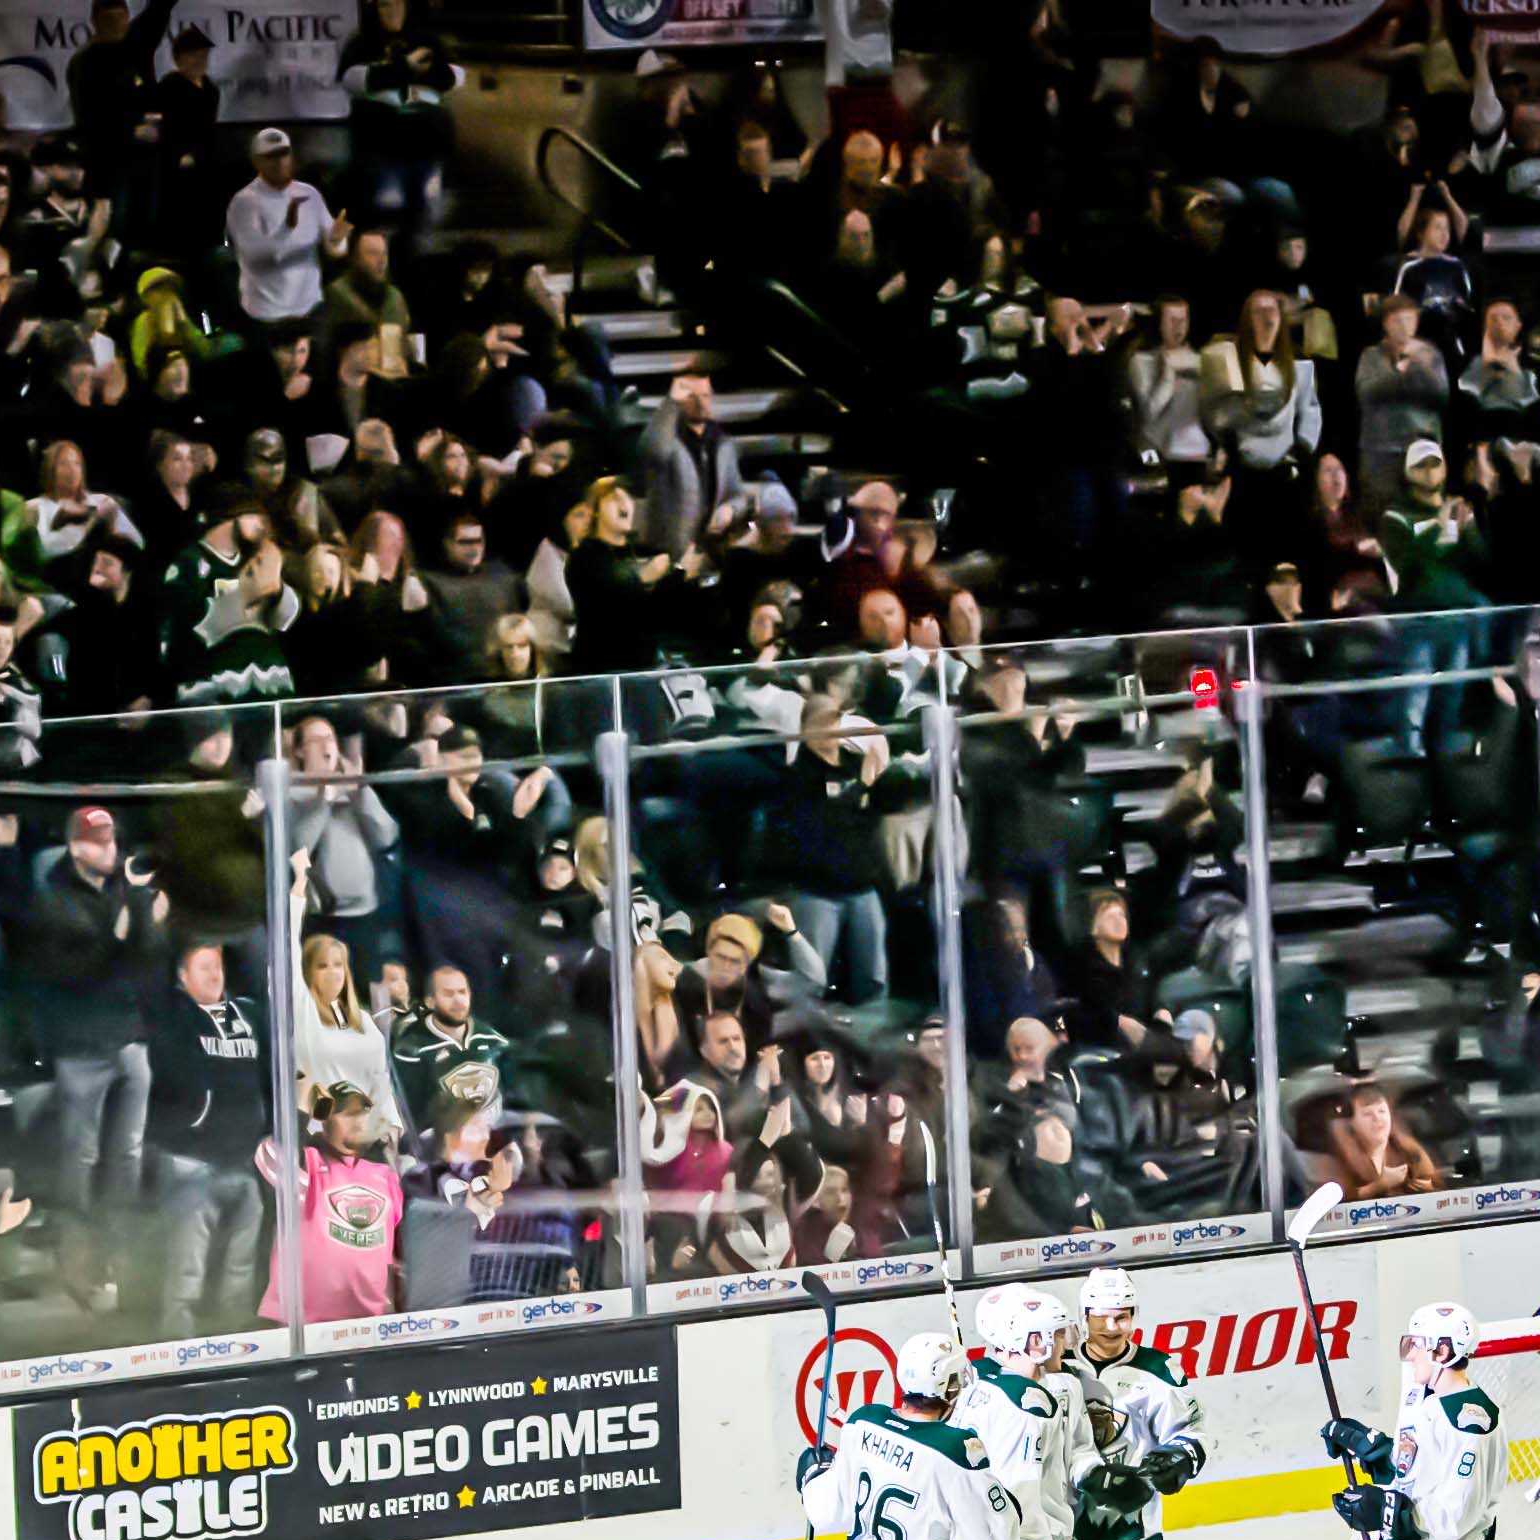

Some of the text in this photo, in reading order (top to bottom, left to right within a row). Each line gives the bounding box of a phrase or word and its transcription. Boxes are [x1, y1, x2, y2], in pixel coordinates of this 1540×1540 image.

[226, 10, 343, 43] PACIFIC
[1475, 1187, 1528, 1210] gerber
[1349, 1201, 1402, 1225] gerber
[1173, 1223, 1229, 1247] gerber
[1041, 1238, 1098, 1262] gerber
[857, 1260, 914, 1284] gerber
[719, 1276, 775, 1301] gerber
[522, 1299, 579, 1323] gerber
[378, 1316, 435, 1340] gerber
[177, 1340, 236, 1366] gerber
[28, 1358, 87, 1383] gerber
[316, 1366, 659, 1421] EDMONDS LYNNWOOD MARYSVILLE
[41, 1415, 291, 1495] ANOTHER
[317, 1402, 660, 1487] VIDEO GAMES
[861, 1430, 915, 1473] KHAIRA
[1457, 1451, 1476, 1478] 8
[319, 1467, 661, 1525] NEW & RETRO ARCADE & PINBALL
[987, 1485, 1006, 1512] 8
